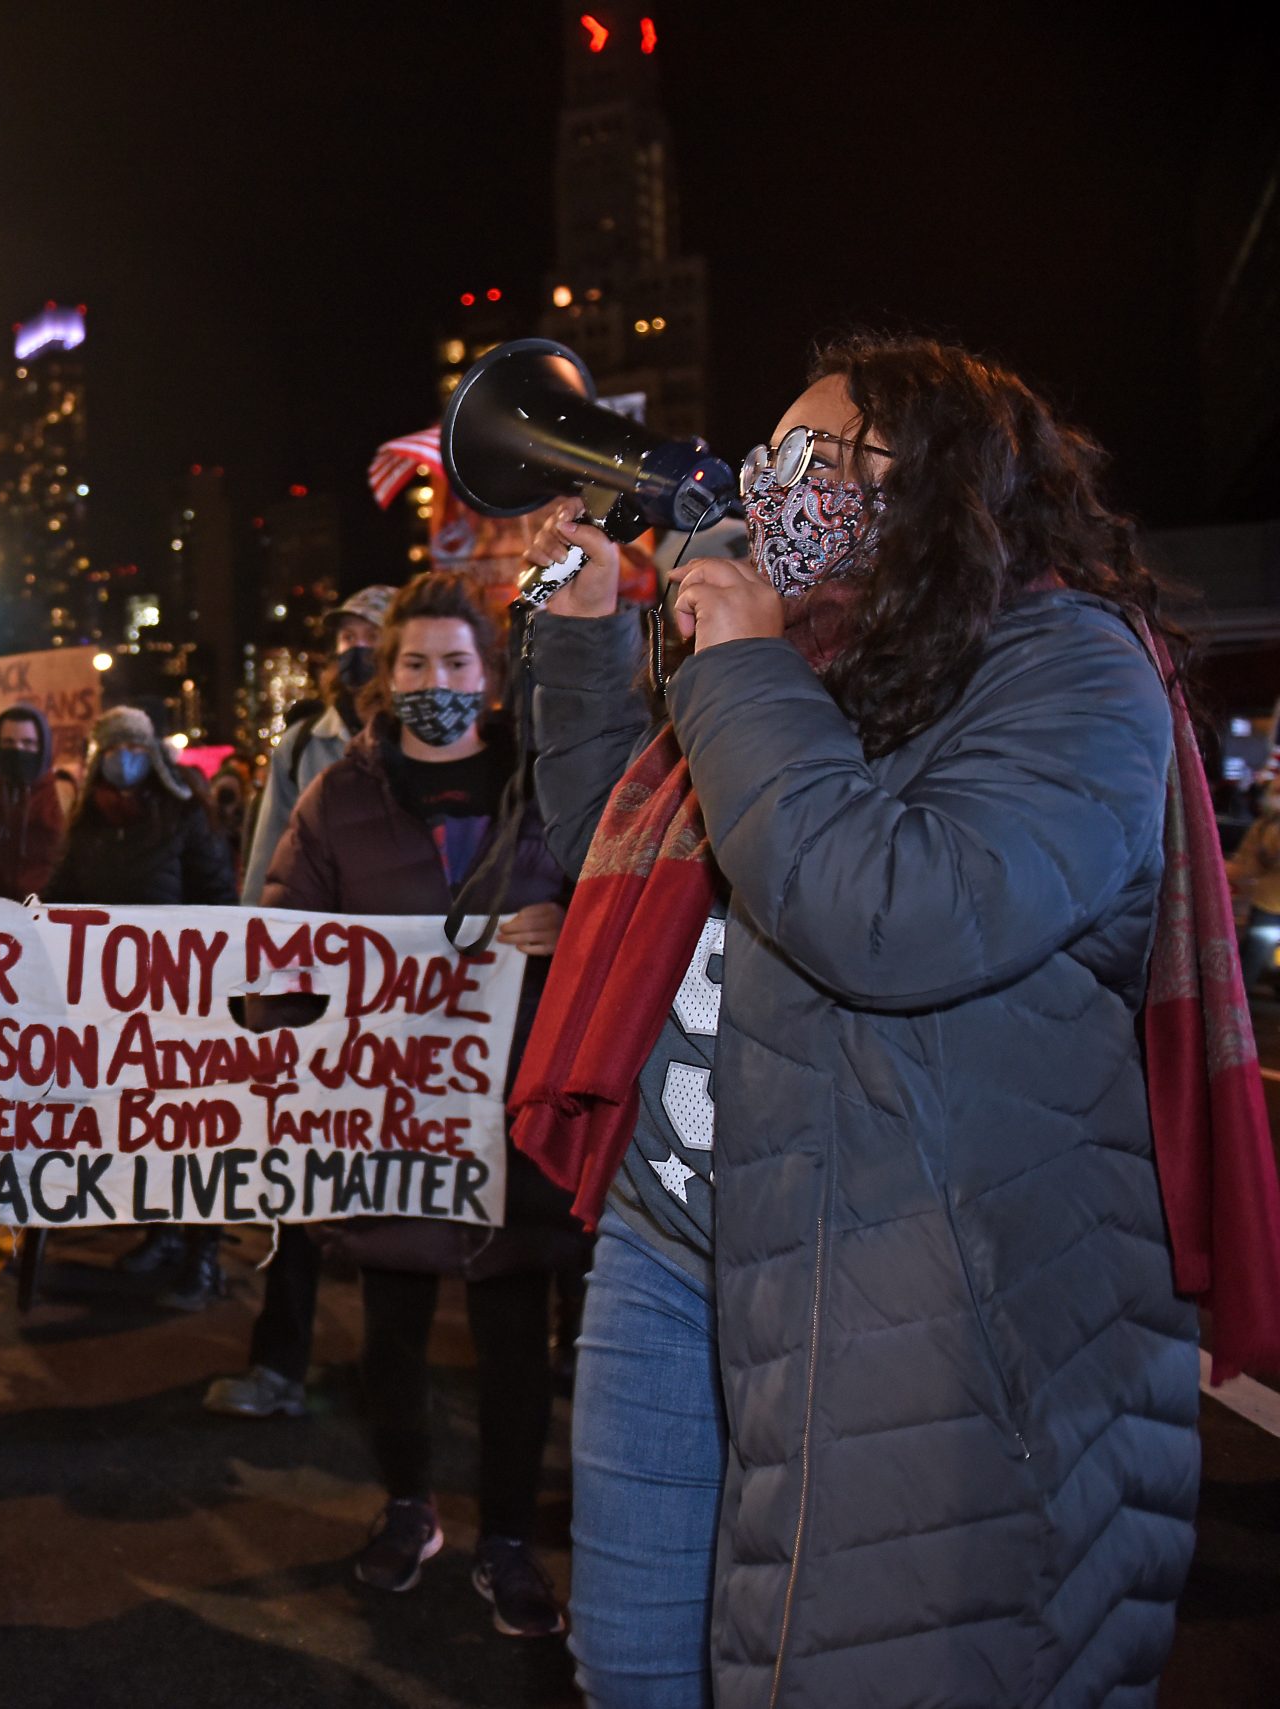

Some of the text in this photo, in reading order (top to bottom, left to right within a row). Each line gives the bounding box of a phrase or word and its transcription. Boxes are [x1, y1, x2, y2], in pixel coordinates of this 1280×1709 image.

[48, 909, 228, 1017] TONY
[106, 1012, 300, 1090] AIYANA
[309, 1016, 491, 1096] JONES
[118, 1087, 242, 1154] BOYD
[249, 1082, 373, 1151] TAMIR
[380, 1086, 476, 1161] RICE
[133, 1148, 296, 1222] LIVES
[303, 1148, 491, 1222] MATTER
